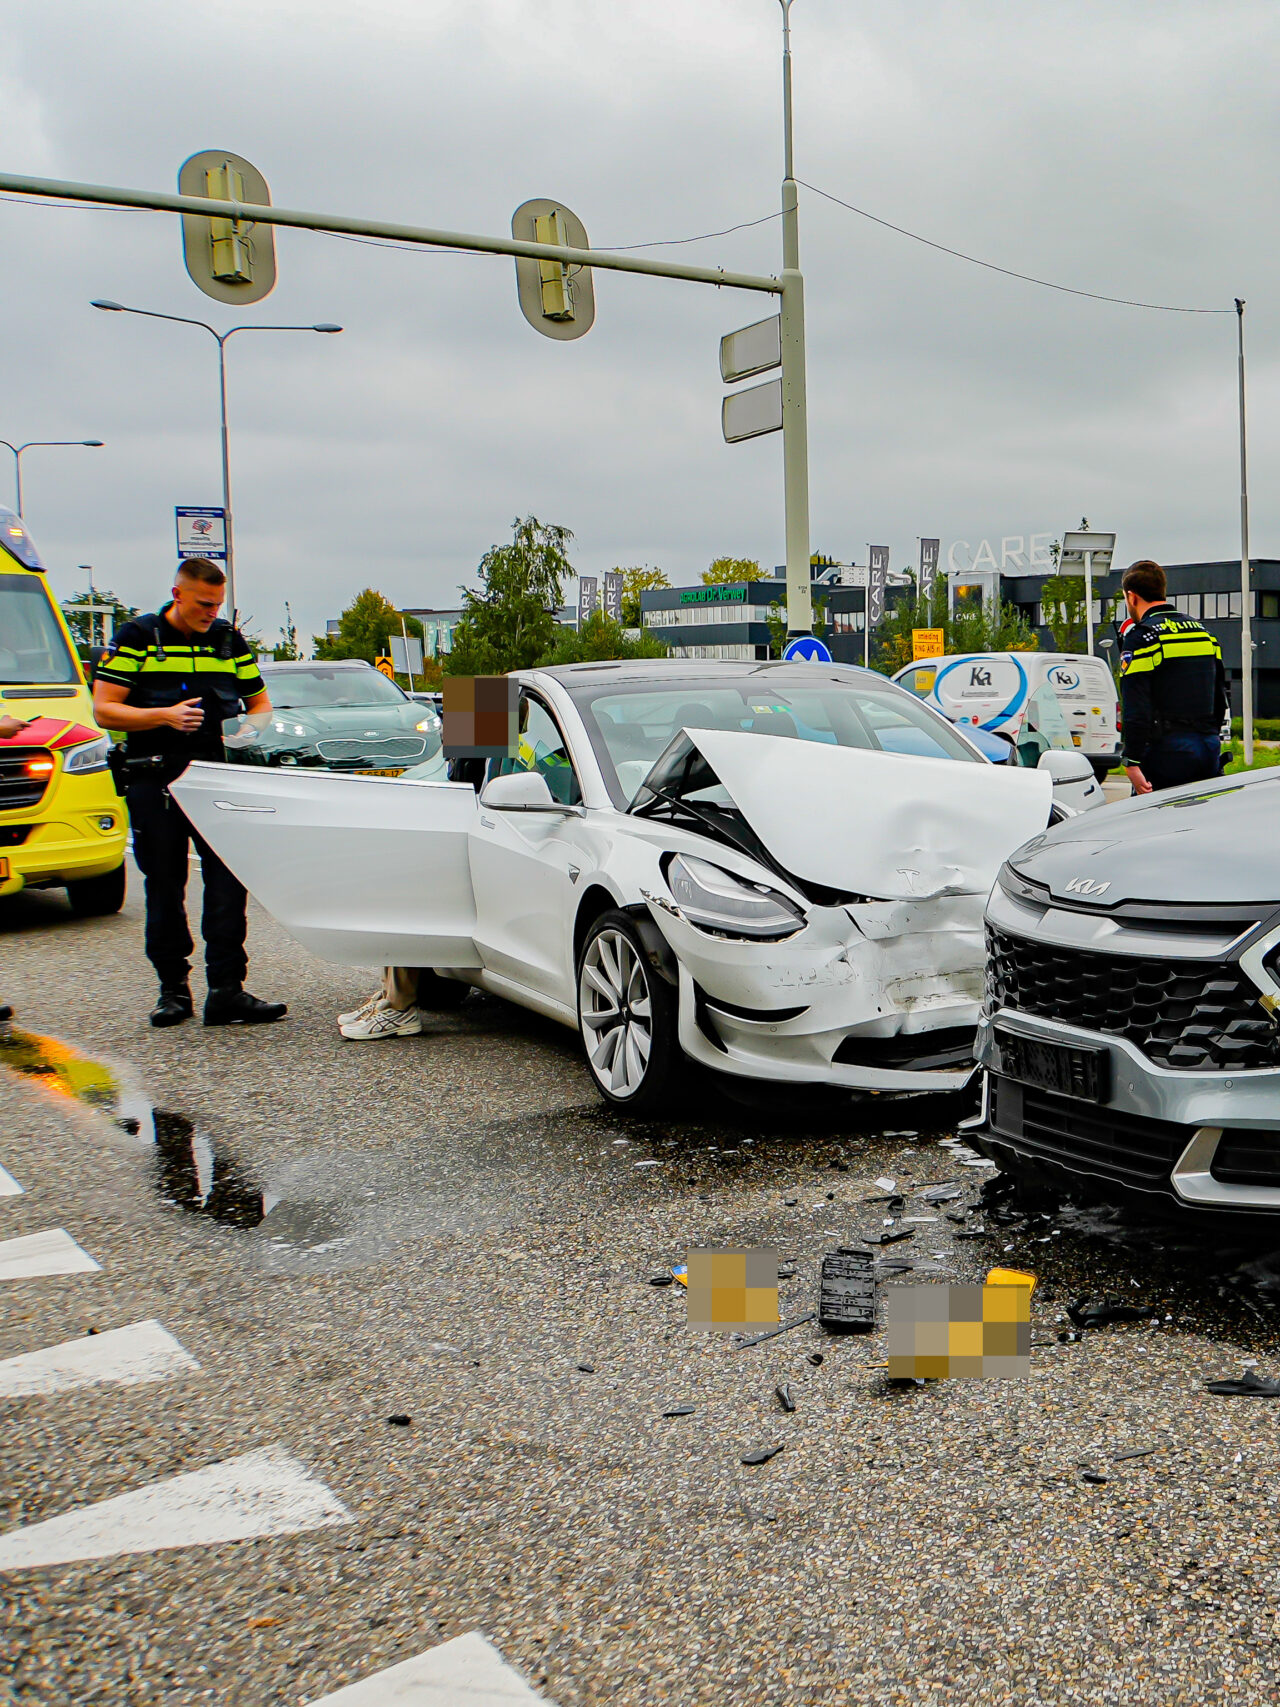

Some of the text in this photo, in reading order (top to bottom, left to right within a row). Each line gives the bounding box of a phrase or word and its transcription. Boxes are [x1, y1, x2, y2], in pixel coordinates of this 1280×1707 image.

[948, 533, 1053, 571] CARE
[870, 553, 882, 622] CARE
[921, 545, 933, 601] ARE
[581, 581, 590, 621] ARE
[607, 577, 616, 620] ARE
[718, 586, 745, 603] Verwey
[970, 666, 992, 687] Ka
[1056, 671, 1074, 685] Ka
